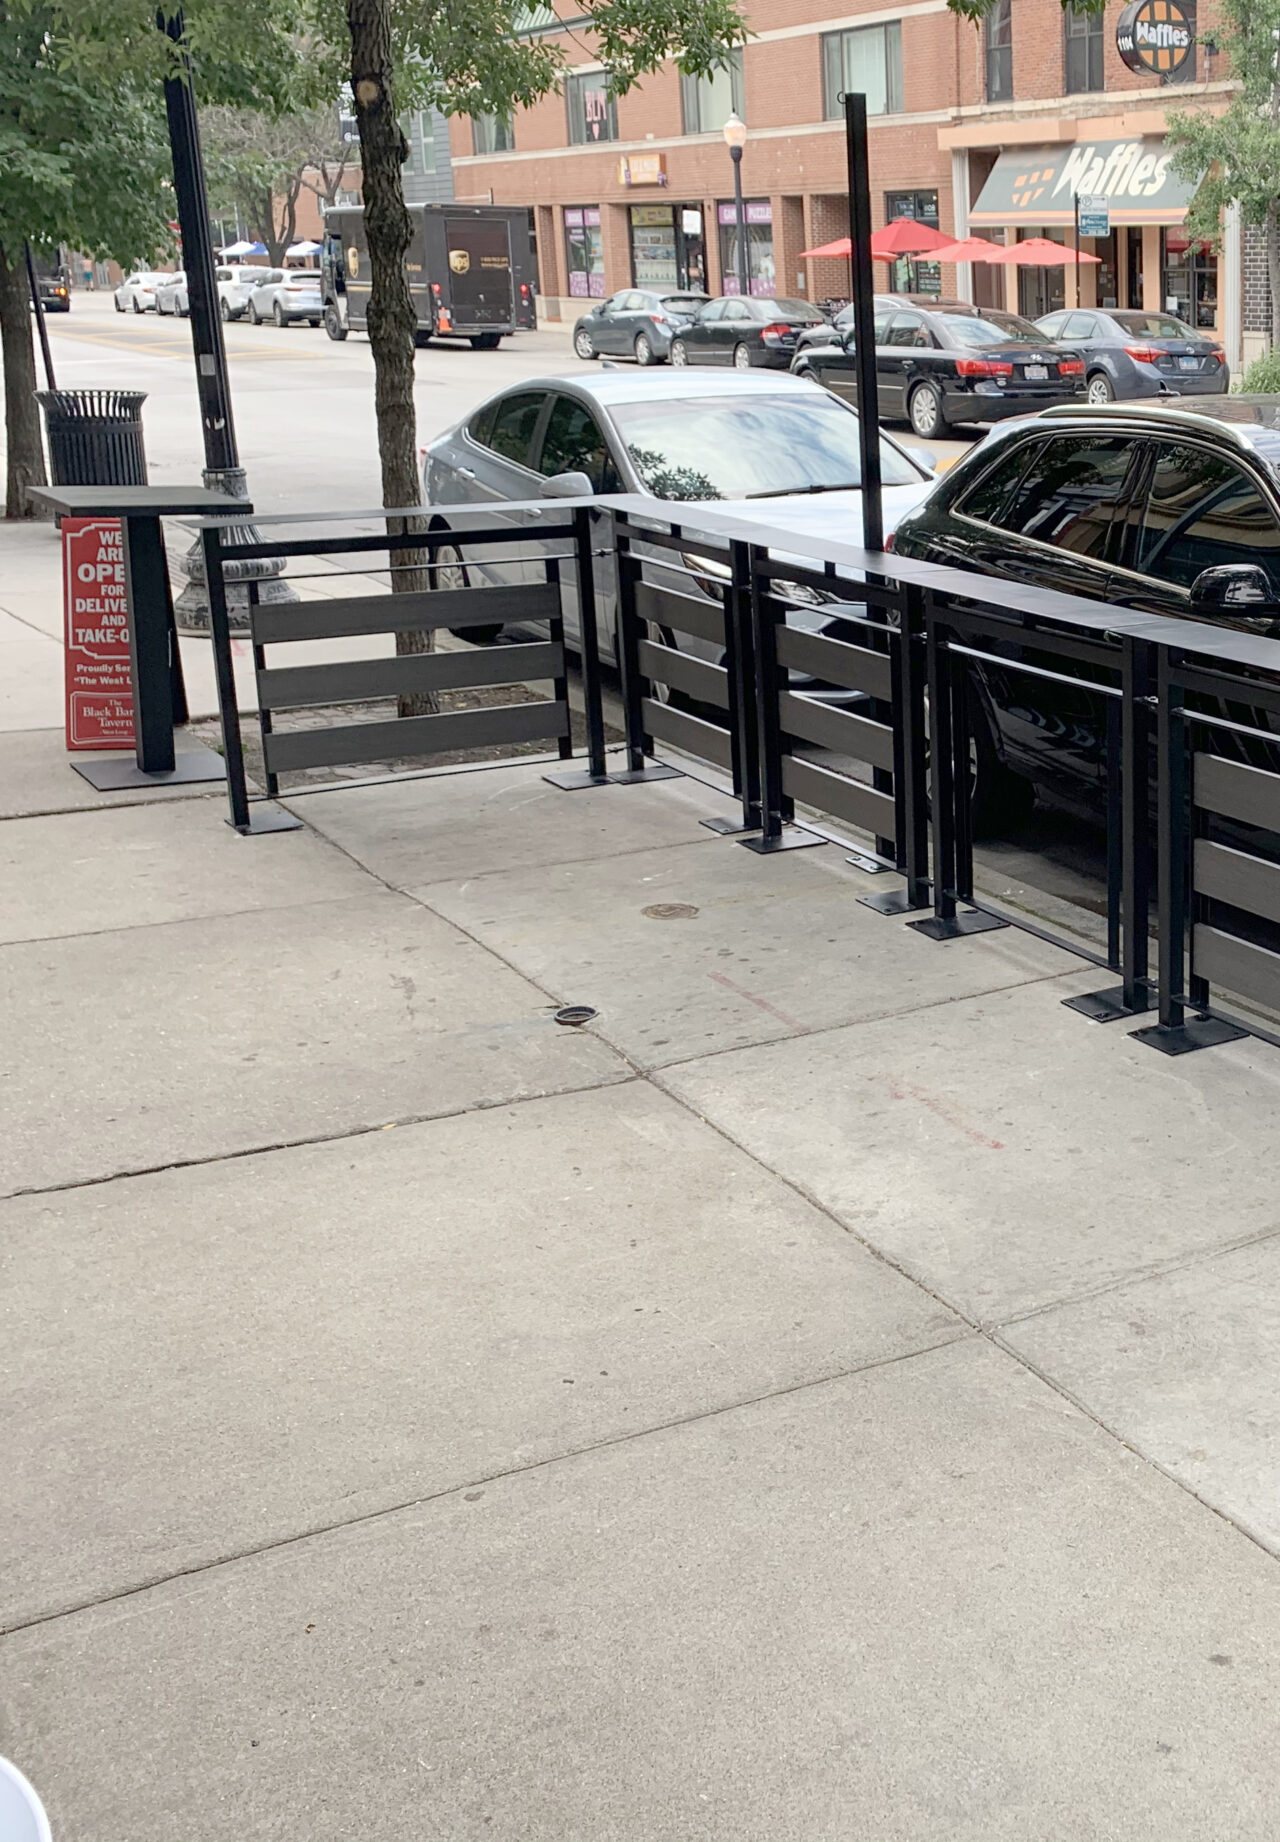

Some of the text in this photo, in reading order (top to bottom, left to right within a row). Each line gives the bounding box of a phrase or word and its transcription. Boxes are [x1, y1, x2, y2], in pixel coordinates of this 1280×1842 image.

[1136, 21, 1189, 48] Waffles
[1051, 142, 1173, 199] Waffles
[99, 530, 123, 545] WE
[77, 562, 125, 583] OPE
[101, 584, 125, 596] FOR
[75, 598, 128, 613] DELIVE
[100, 614, 126, 626] AND
[74, 628, 130, 643] TAKE-O
[76, 664, 131, 673] Proudly Ser
[100, 676, 124, 684] West
[83, 707, 134, 717] Black Bar
[98, 717, 133, 727] Tavern
